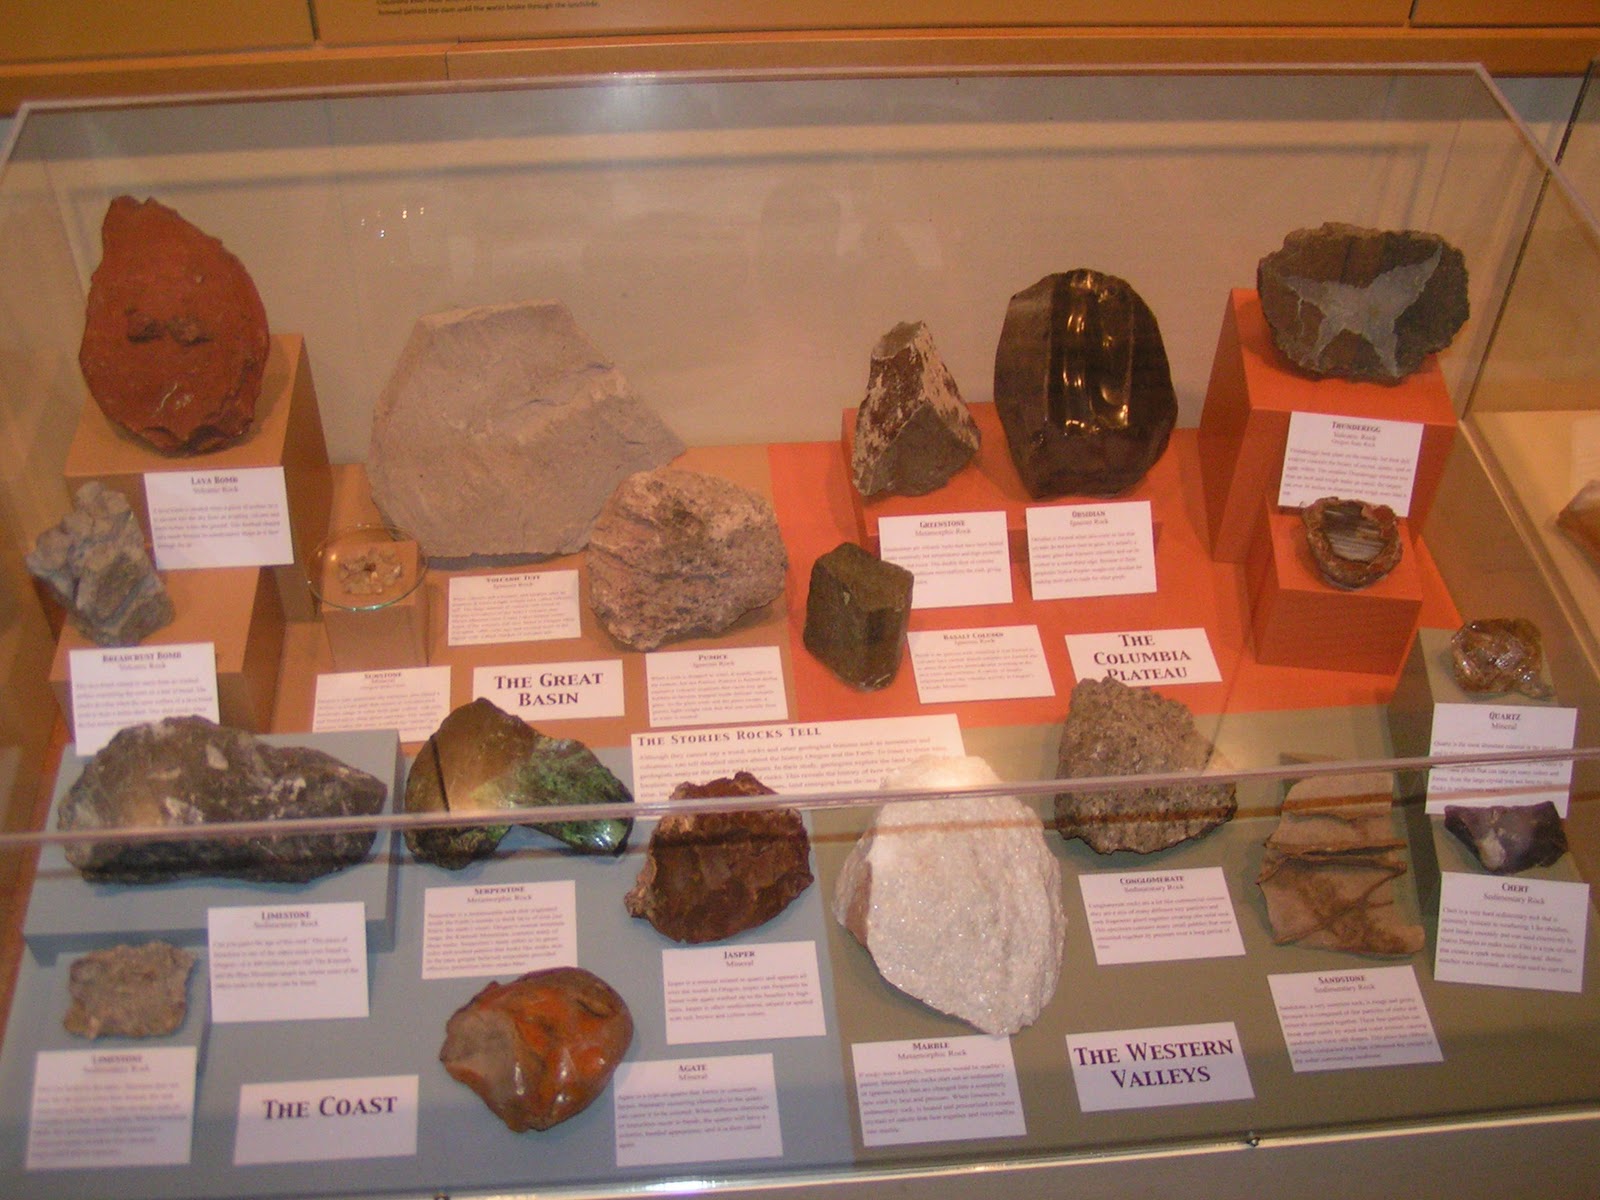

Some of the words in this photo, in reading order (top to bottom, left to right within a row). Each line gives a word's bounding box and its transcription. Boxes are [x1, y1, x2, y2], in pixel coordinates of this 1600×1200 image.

[1332, 422, 1381, 432] THUNDEREGG
[192, 477, 212, 485] LAVA
[214, 476, 238, 484] BOMB
[920, 520, 966, 528] GREENSTONE
[1119, 634, 1156, 647] THE
[1094, 650, 1192, 665] COLUMBIA
[1107, 667, 1188, 682] PLATEAU
[494, 676, 533, 690] THE
[540, 673, 604, 688] GREAT
[519, 692, 579, 707] BASIN
[1489, 712, 1522, 721] QUARTZ
[637, 736, 666, 746] THE
[671, 733, 731, 745] STORIES
[737, 728, 783, 740] ROCKS
[788, 727, 822, 737] TELL
[1120, 876, 1184, 885] CONGLOMERATE
[474, 886, 525, 895] SERPENTINE
[1501, 883, 1529, 893] CHERT
[1483, 893, 1526, 904] Sedimentary
[1528, 896, 1545, 905] Rock
[261, 911, 310, 920] LIMESTONE
[724, 951, 756, 960] JASPER
[726, 960, 754, 968] Mineral
[1318, 975, 1366, 984] SANDSTONE
[1314, 985, 1357, 994] Sedimentary
[913, 1042, 949, 1051] MARBLE
[898, 1052, 946, 1061] Metamorphic
[1073, 1047, 1121, 1066] THE
[1126, 1039, 1234, 1062] WESTERN
[678, 1064, 708, 1073] AGATE
[1110, 1066, 1212, 1089] VALLEYS
[263, 1099, 311, 1120] THE
[319, 1095, 398, 1117] COAST
